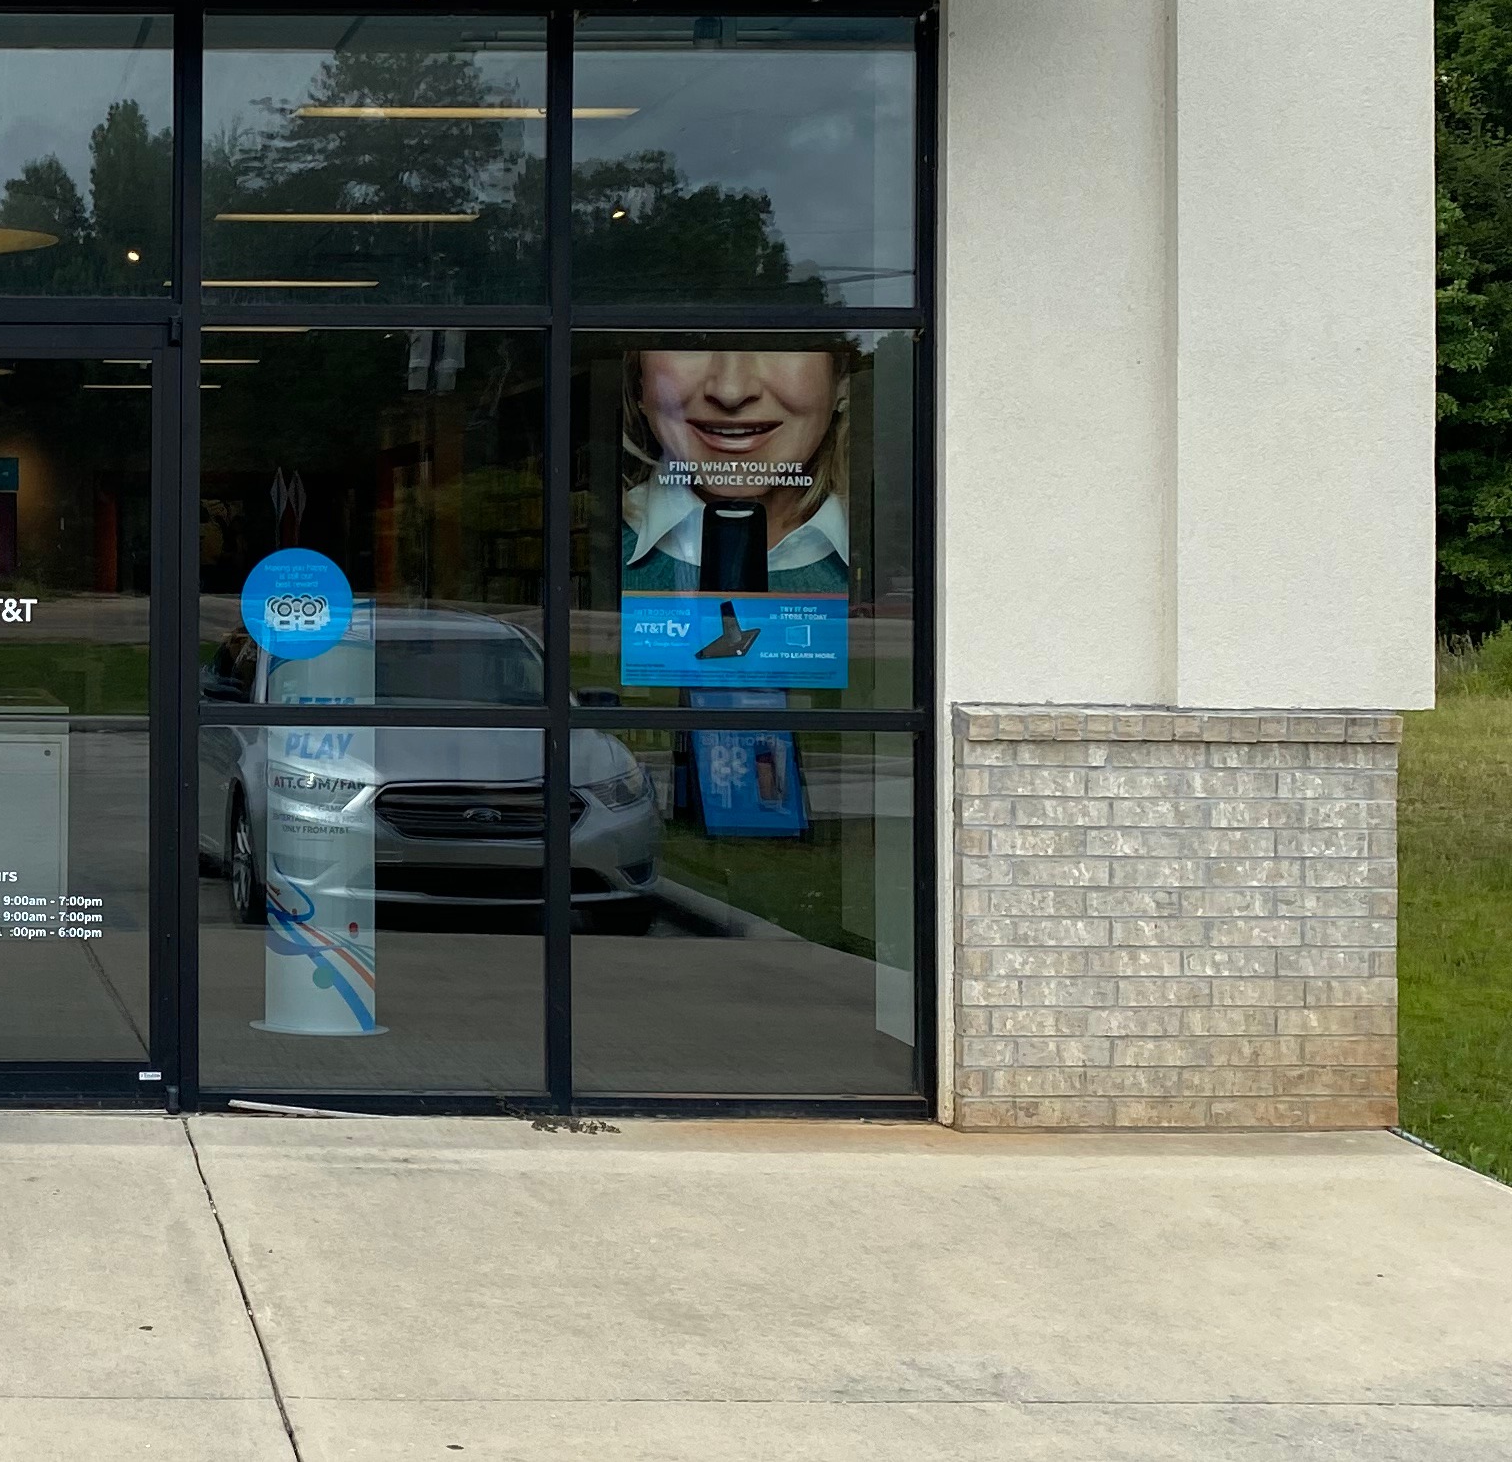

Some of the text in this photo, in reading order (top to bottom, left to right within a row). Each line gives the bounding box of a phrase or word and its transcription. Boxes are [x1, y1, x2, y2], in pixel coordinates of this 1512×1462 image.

[669, 461, 803, 473] FIND WHAT YOU LOVE
[658, 474, 814, 487] WITH A VOICE COMMAND
[634, 619, 690, 638] AT&T tv
[285, 732, 356, 760] PLAY
[283, 824, 351, 835] ONLY FROM AT&T
[3, 895, 47, 907] 9:00am
[58, 896, 103, 909] 7:00pm
[3, 911, 47, 922] 9:00am
[58, 912, 103, 925] 7:00pm
[58, 927, 103, 940] 6:00pm
